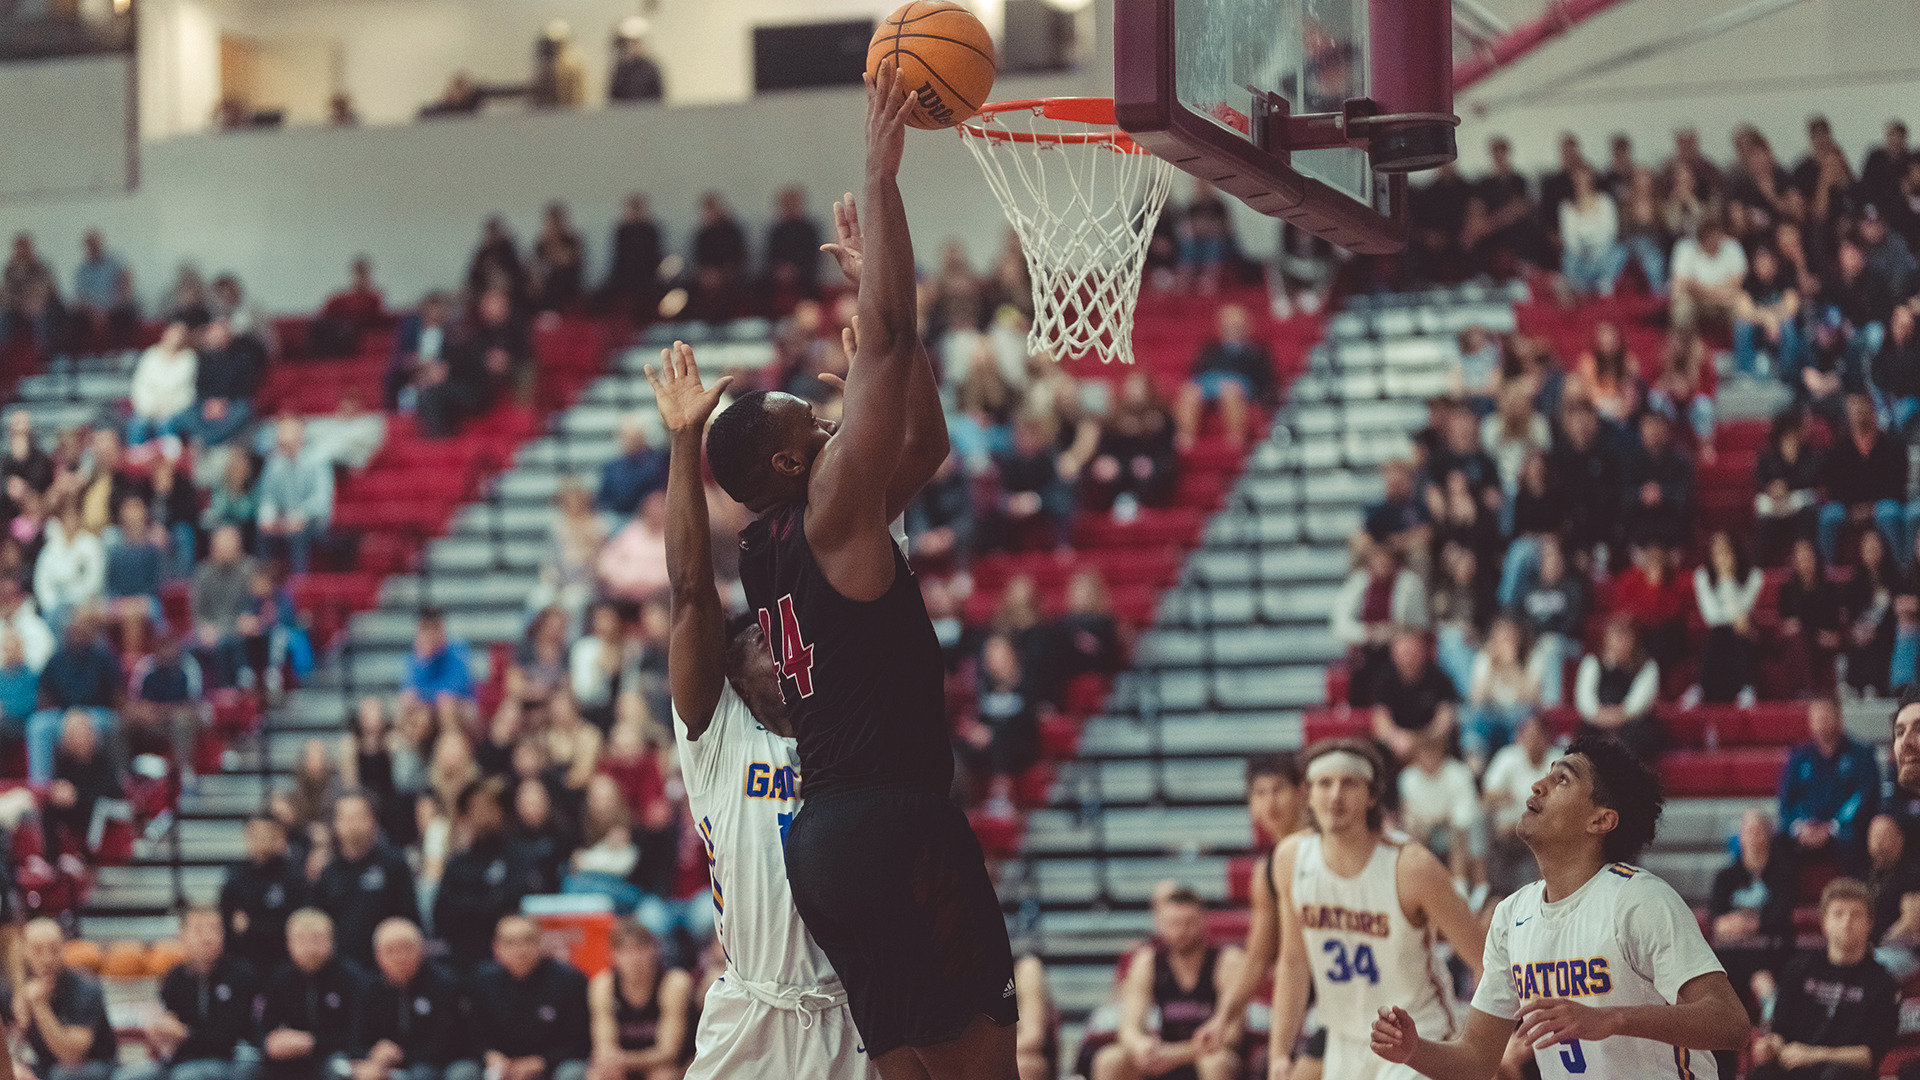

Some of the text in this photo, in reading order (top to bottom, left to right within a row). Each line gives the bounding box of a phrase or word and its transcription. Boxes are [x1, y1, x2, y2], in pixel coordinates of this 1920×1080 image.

[916, 80, 957, 125] Wils
[745, 760, 803, 803] GAT
[1301, 904, 1391, 939] GATORS
[1323, 939, 1380, 985] 34
[1512, 955, 1614, 1001] GATORS
